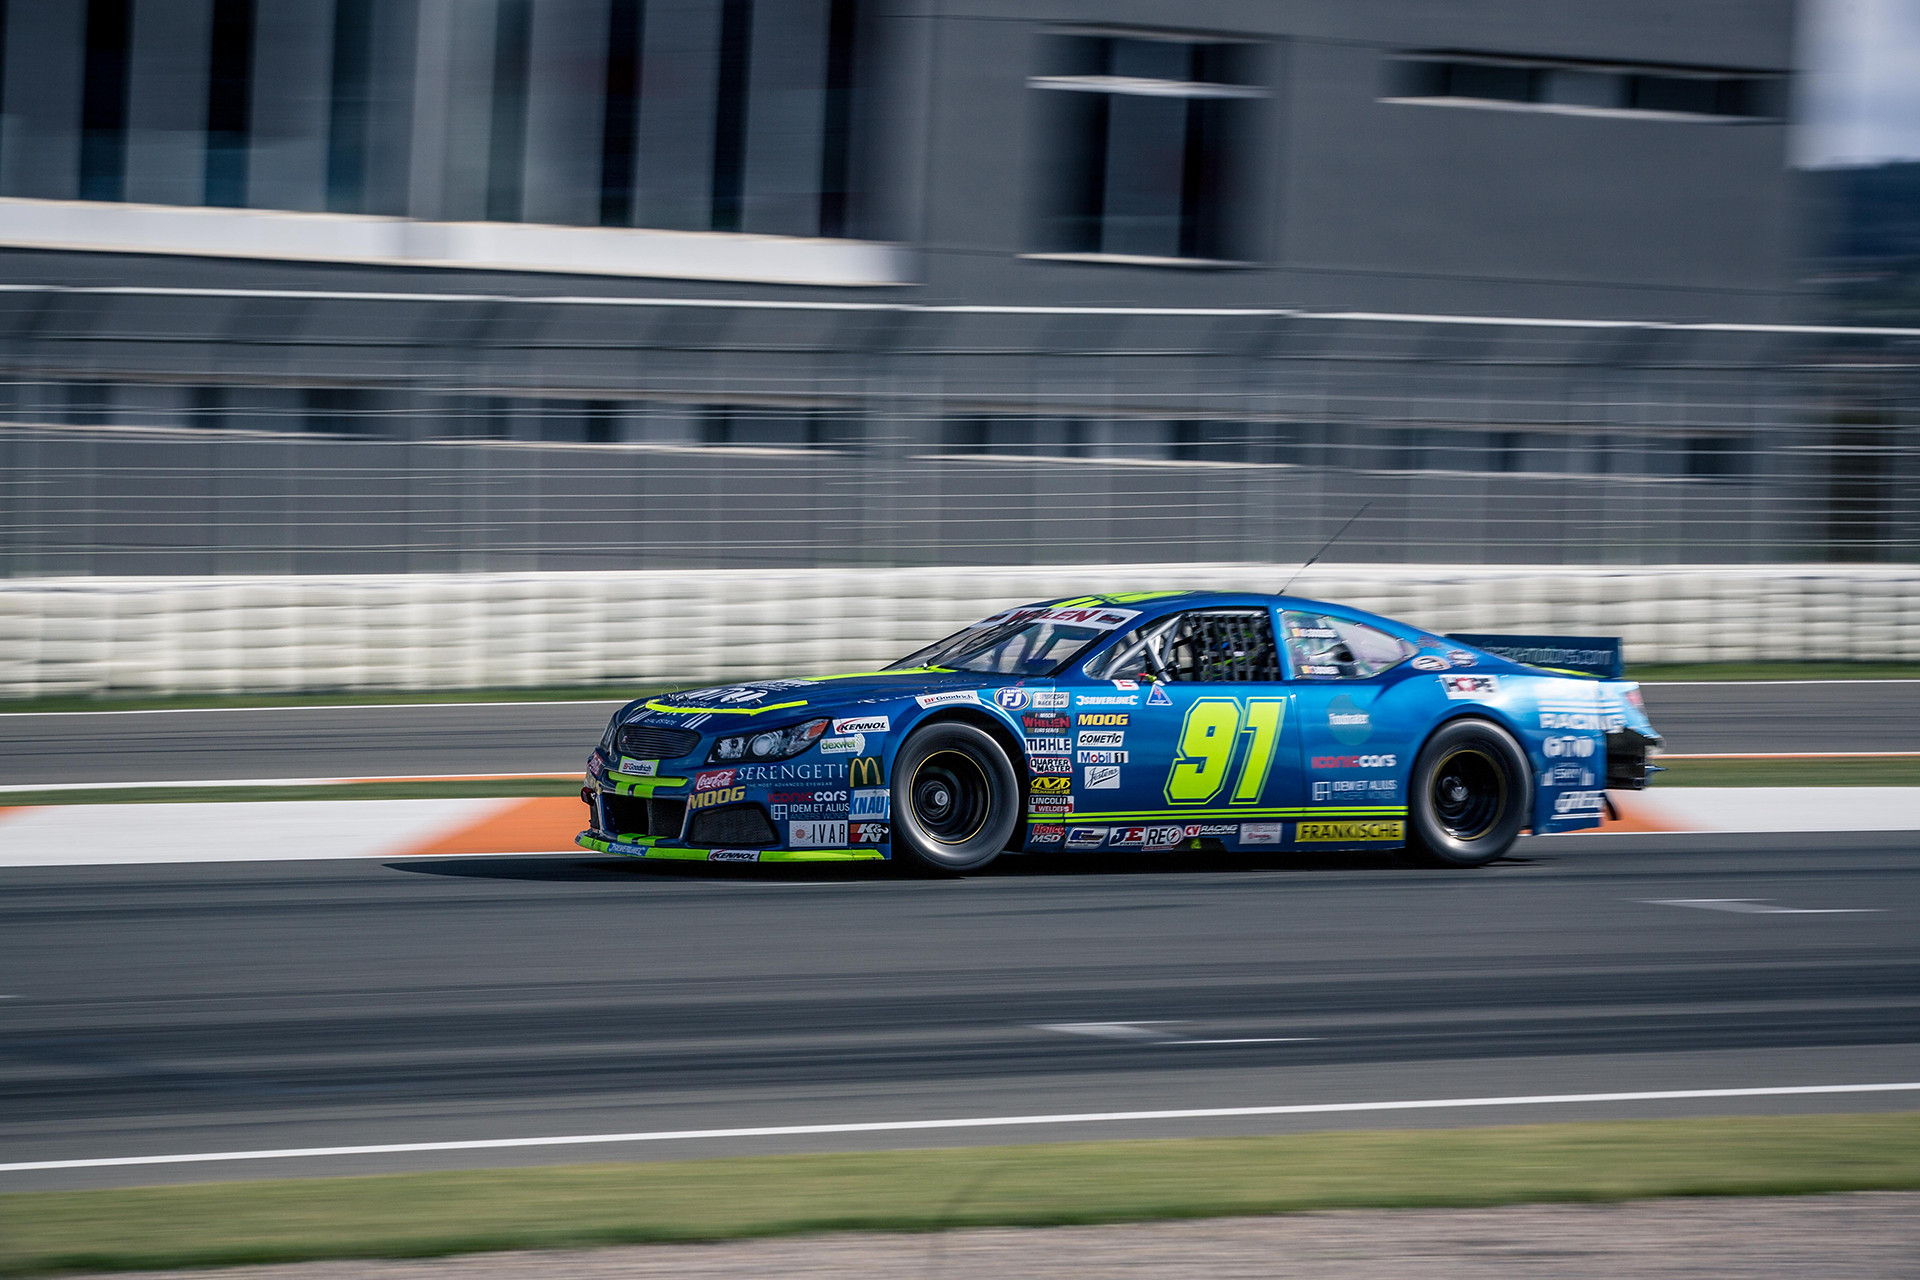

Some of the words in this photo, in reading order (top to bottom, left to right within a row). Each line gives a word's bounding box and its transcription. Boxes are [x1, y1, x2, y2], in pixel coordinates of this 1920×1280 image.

[1002, 693, 1022, 706] FJ
[1022, 716, 1071, 728] WHELEN
[1078, 714, 1129, 725] MOOG
[1539, 713, 1624, 733] RACING
[840, 722, 887, 731] KENNOL
[1079, 733, 1122, 743] COMETIC
[821, 740, 856, 750] dexwet
[1026, 739, 1071, 751] MAHLE
[1163, 697, 1286, 805] 91
[1081, 752, 1112, 763] Mobil
[1115, 752, 1125, 763] 1
[623, 762, 652, 772] BFGoodrich
[1030, 758, 1069, 768] QUARTER
[737, 763, 845, 781] SERENGETI
[1037, 764, 1071, 773] MASTER
[689, 786, 746, 810] MOOG
[1031, 797, 1067, 805] LINCOLN
[790, 804, 812, 813] IDEM
[814, 803, 824, 812] ET
[825, 803, 850, 812] ALIUS
[1038, 804, 1070, 812] WELDERS
[812, 823, 845, 844] IVAR
[857, 823, 889, 842] K&N
[1032, 824, 1065, 836] Holley
[1185, 825, 1200, 835] CV
[1031, 835, 1061, 843] MSD
[713, 852, 757, 860] KENNOL
